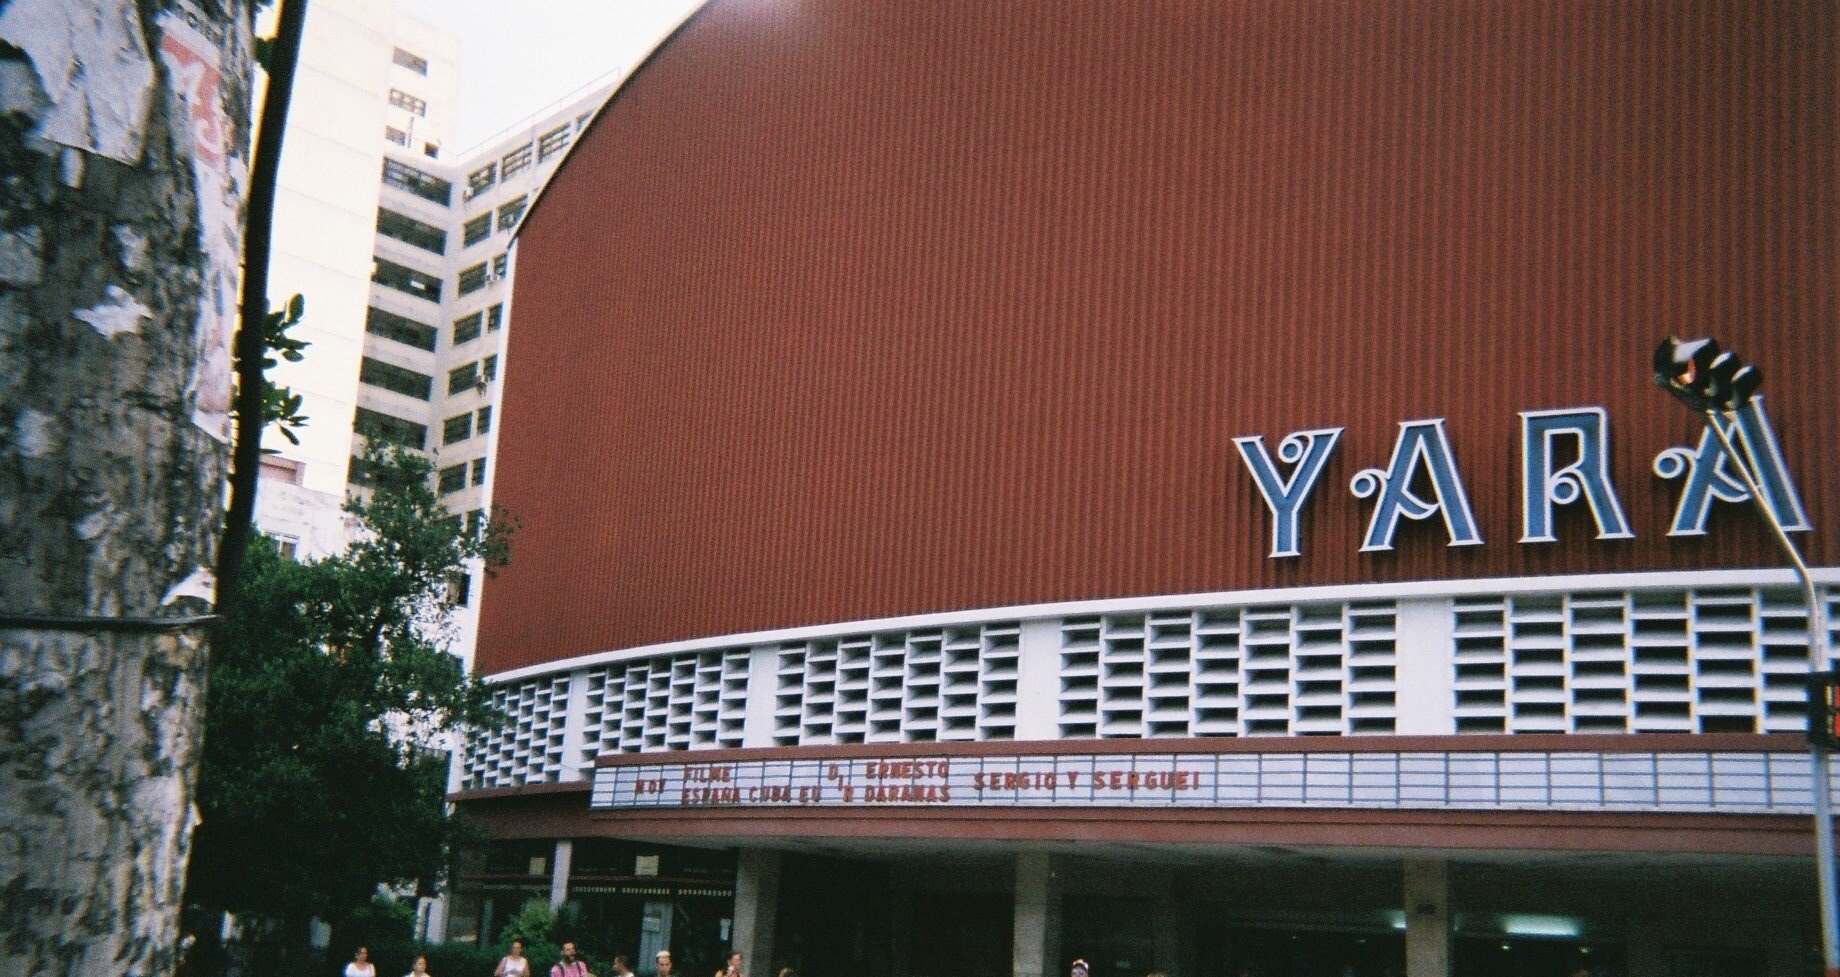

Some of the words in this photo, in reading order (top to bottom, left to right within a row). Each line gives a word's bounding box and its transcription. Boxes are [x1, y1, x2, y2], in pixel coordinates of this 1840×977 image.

[1230, 394, 1813, 558] YARA
[684, 767, 731, 783] FILME
[866, 761, 949, 779] ERNESTO
[972, 771, 1057, 790] SERGIO
[1068, 771, 1079, 790] Y
[1093, 771, 1200, 790] SERGUEI
[748, 785, 792, 803] CUBA
